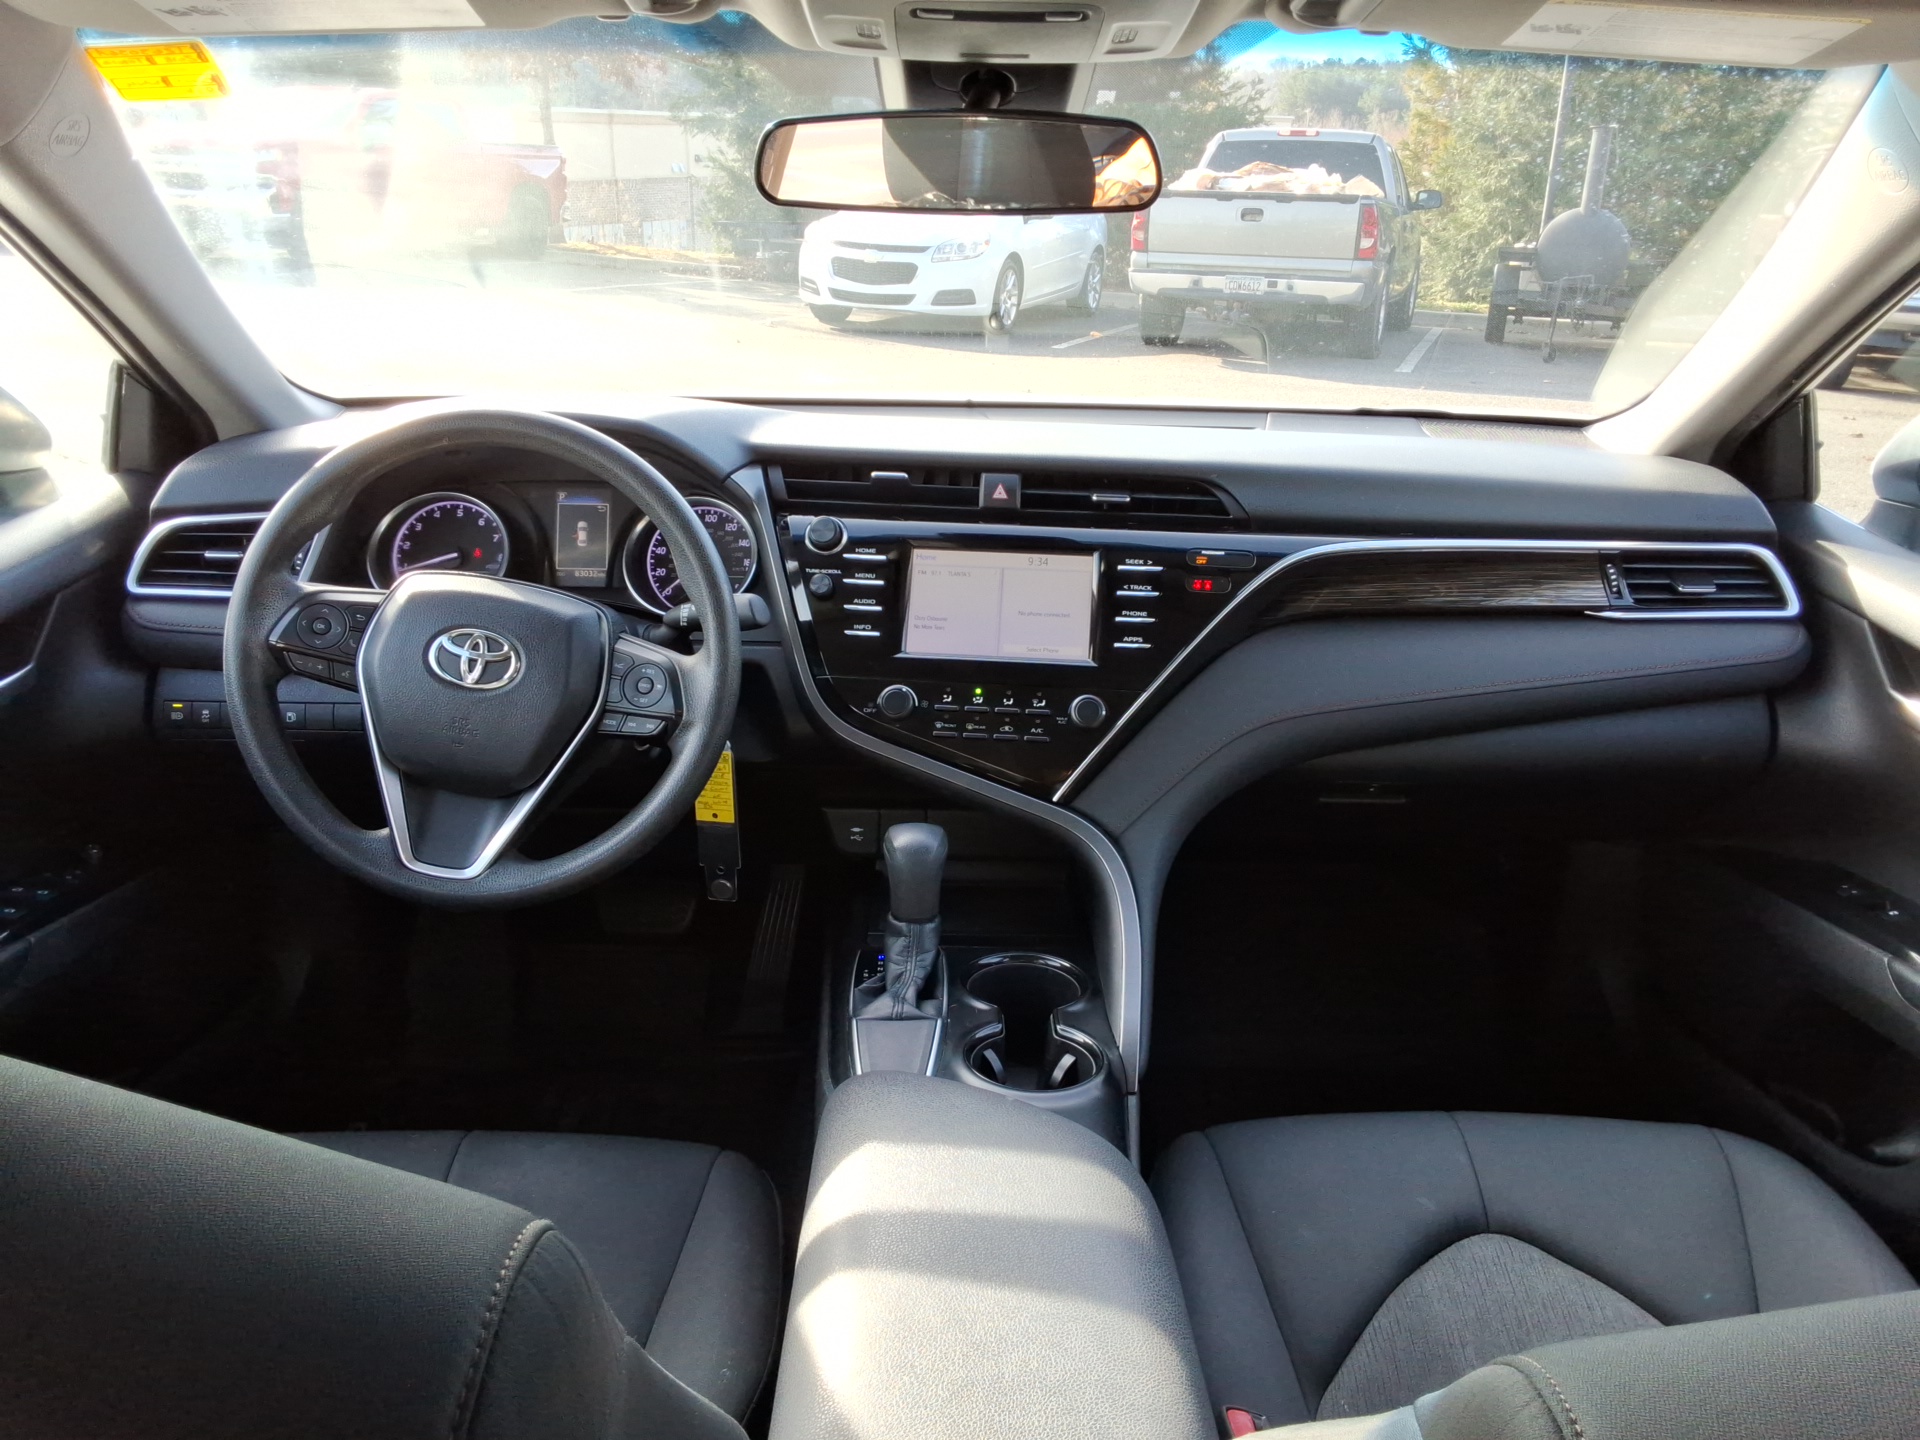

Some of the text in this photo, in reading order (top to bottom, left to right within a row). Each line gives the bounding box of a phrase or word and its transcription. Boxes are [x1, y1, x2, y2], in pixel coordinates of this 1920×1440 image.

[433, 510, 441, 518] 4
[456, 508, 464, 517] 5
[477, 518, 486, 527] 6
[704, 514, 718, 523] 100
[415, 522, 423, 531] 3
[724, 523, 738, 531] 120
[492, 534, 501, 542] 7
[402, 541, 411, 550] 2
[738, 539, 751, 547] 140
[655, 546, 667, 555] 40
[1026, 556, 1050, 567] 9:34
[655, 568, 667, 576] 20
